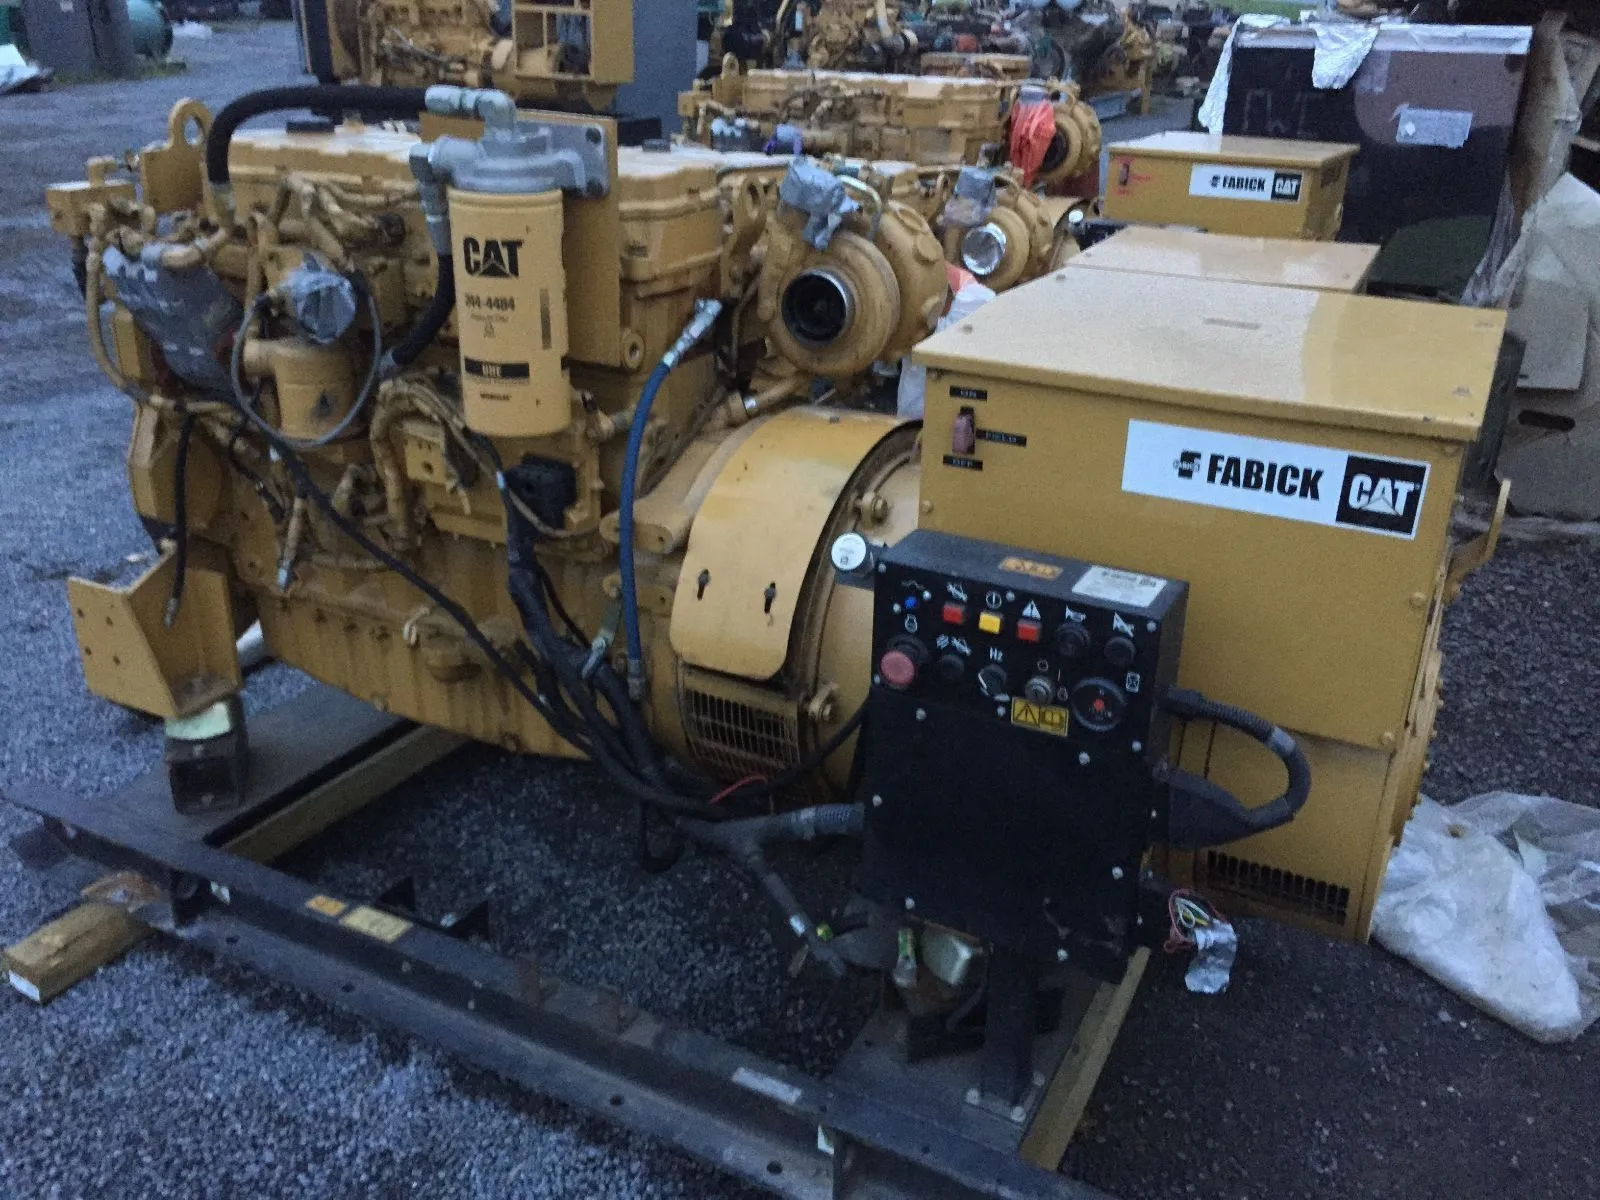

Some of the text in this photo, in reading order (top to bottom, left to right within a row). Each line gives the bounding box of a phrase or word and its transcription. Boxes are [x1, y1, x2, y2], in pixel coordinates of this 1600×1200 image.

[1222, 175, 1299, 196] FABICK CAT
[463, 236, 525, 279] CAT
[1206, 453, 1415, 517] FABICK CAT
